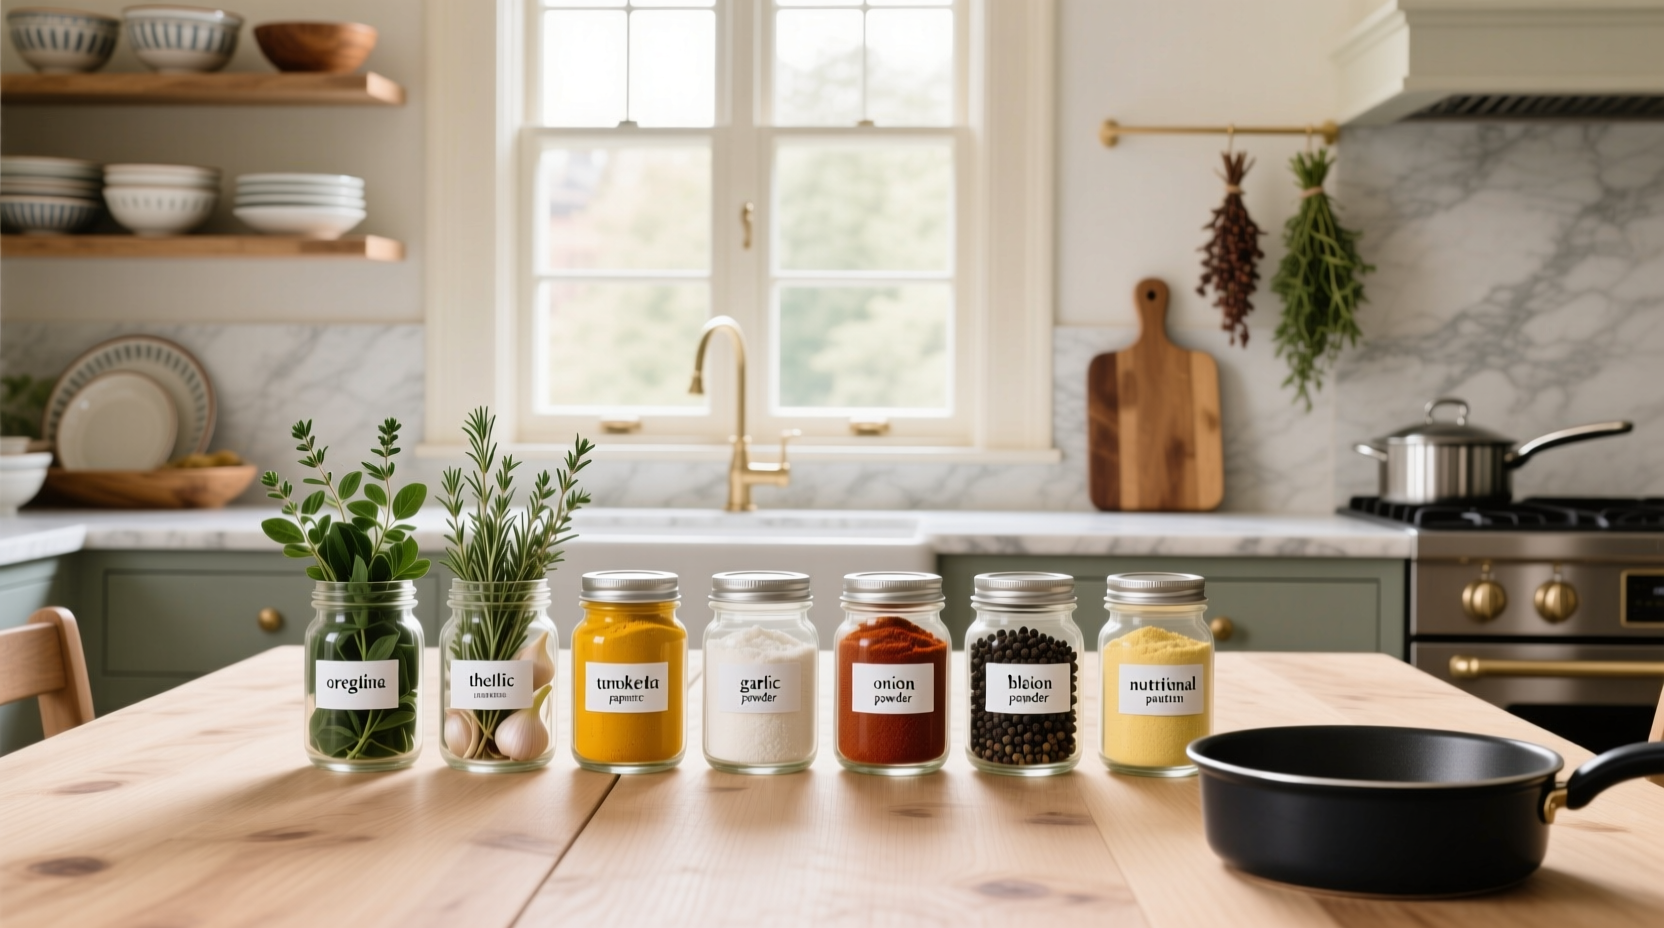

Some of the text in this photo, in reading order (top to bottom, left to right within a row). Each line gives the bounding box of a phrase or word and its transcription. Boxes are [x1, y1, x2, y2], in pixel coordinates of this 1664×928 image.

[740, 675, 781, 693] garlic
[874, 676, 915, 690] onion
[741, 692, 777, 705] powder
[874, 692, 912, 706] powder
